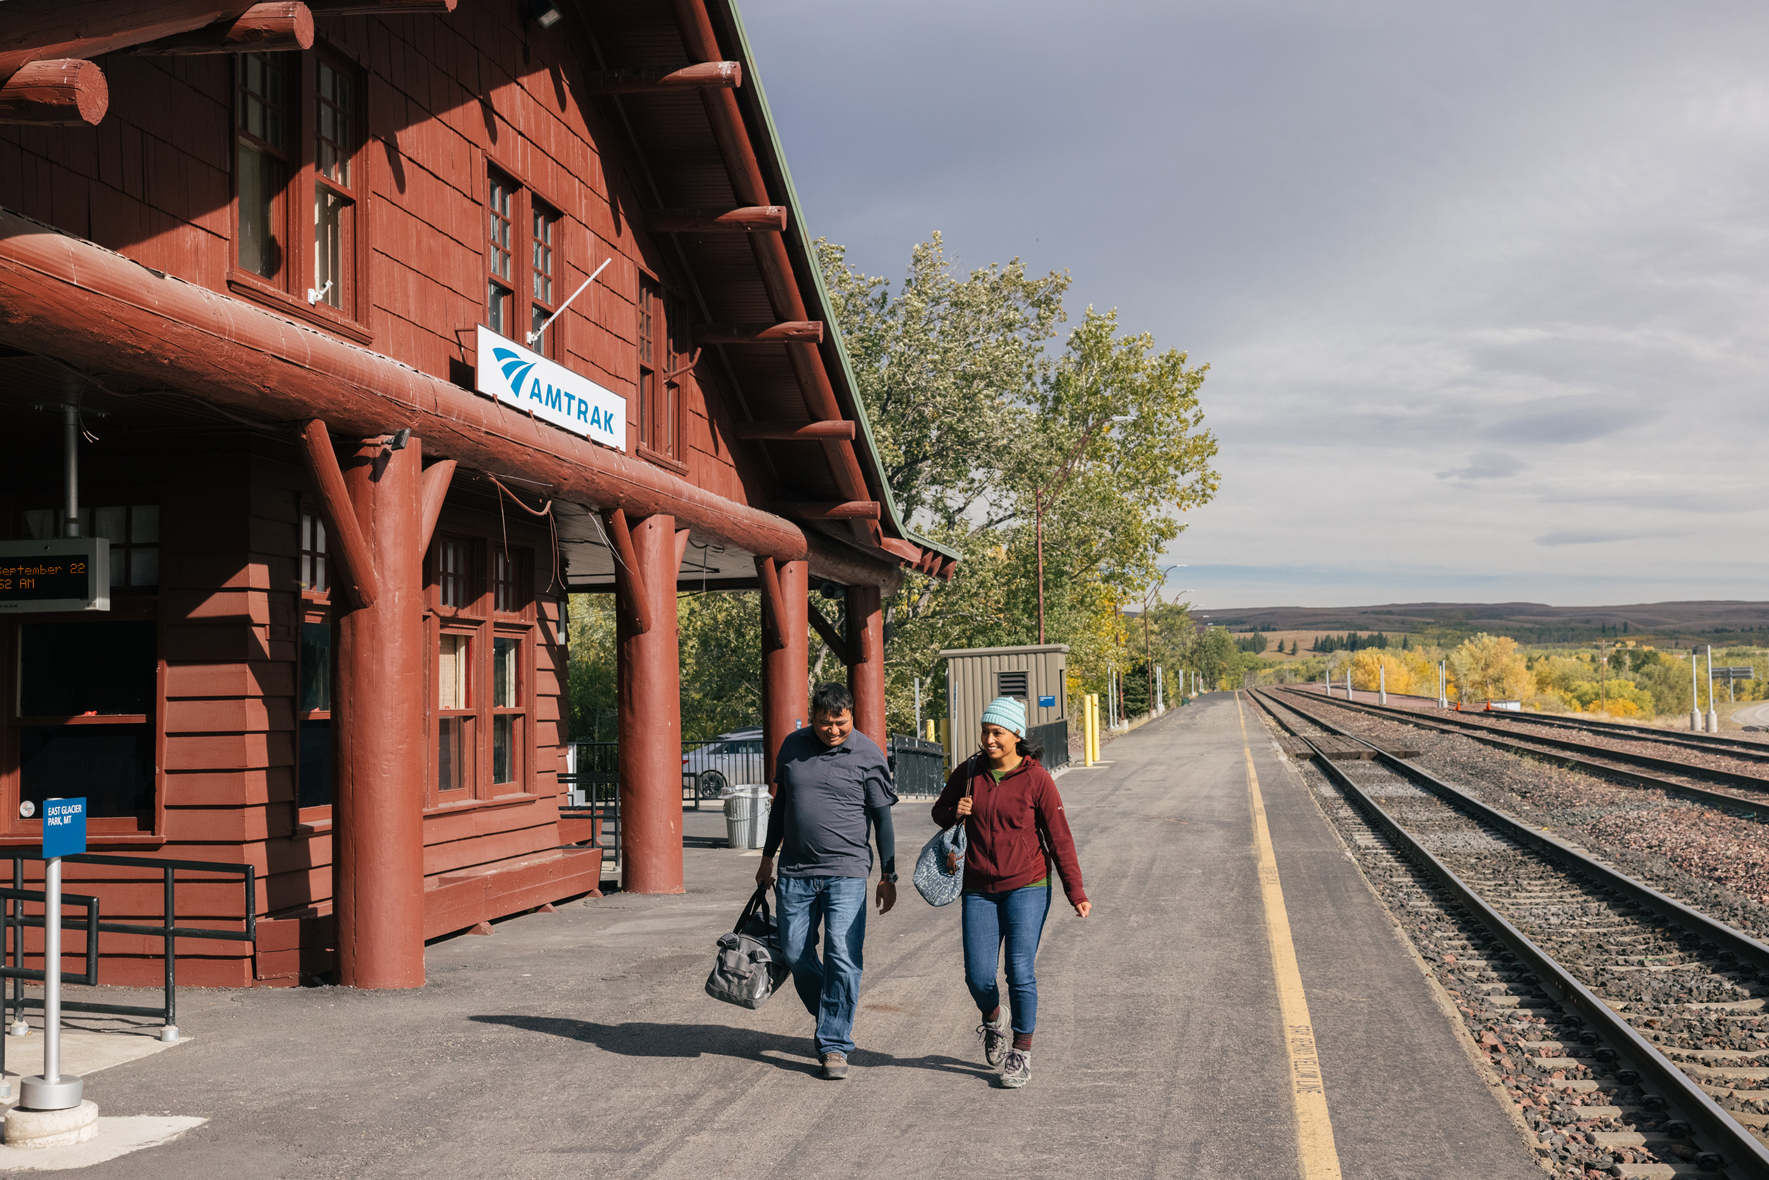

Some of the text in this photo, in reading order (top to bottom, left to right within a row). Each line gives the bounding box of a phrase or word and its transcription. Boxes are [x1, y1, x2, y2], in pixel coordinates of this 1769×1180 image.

[529, 377, 615, 435] AMTRAK
[0, 563, 86, 575] eptember 22
[20, 578, 35, 589] AM
[48, 804, 82, 816] EAST GLACIER
[48, 815, 72, 826] PARK, MT
